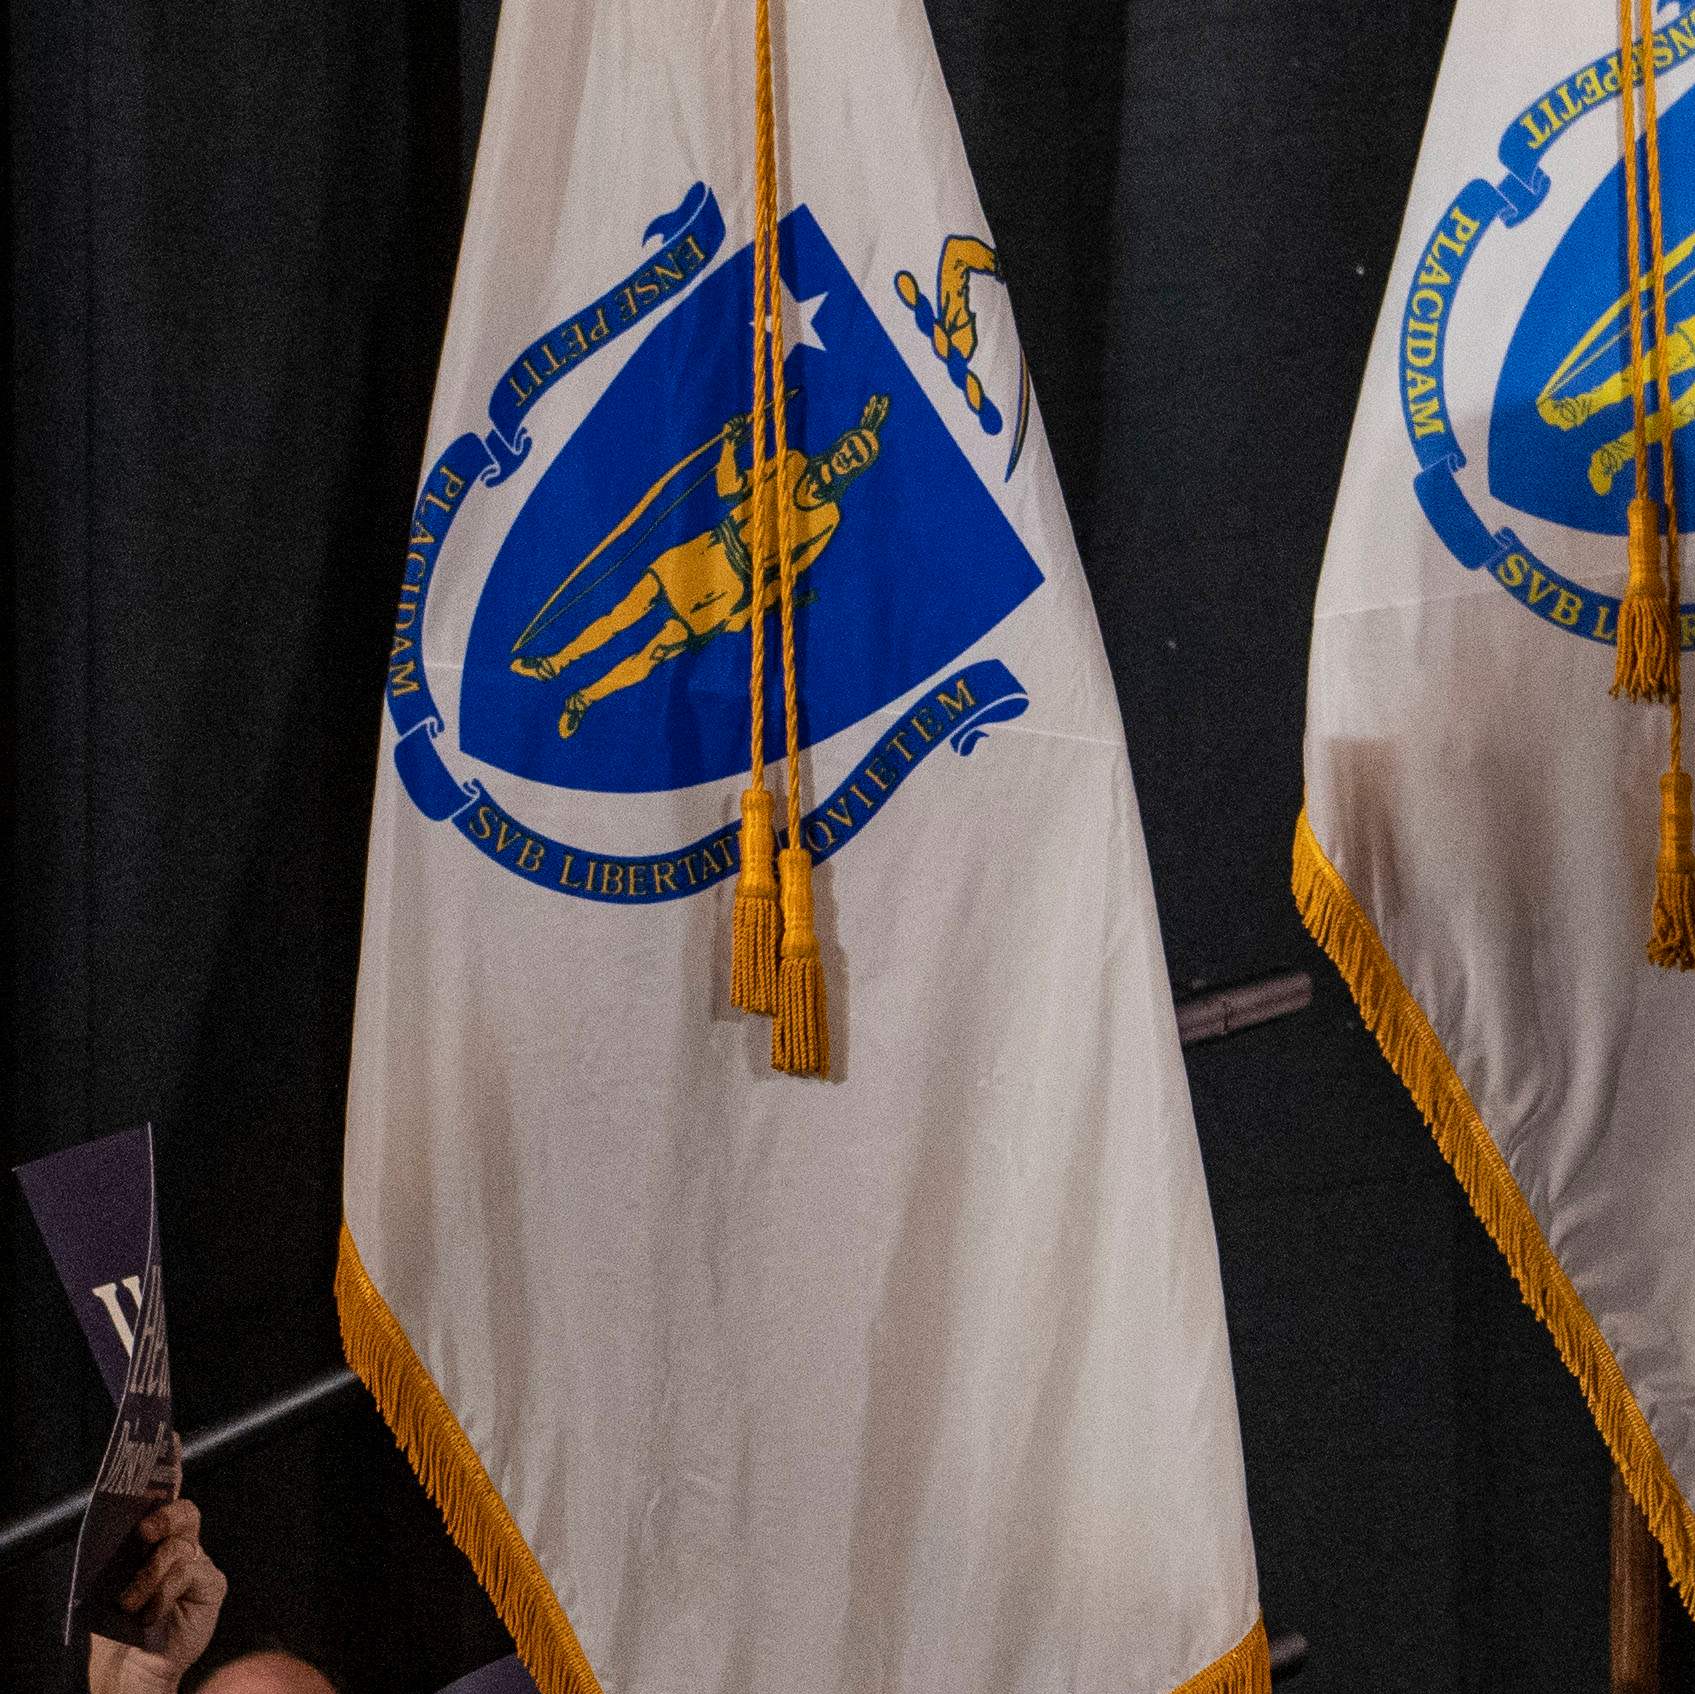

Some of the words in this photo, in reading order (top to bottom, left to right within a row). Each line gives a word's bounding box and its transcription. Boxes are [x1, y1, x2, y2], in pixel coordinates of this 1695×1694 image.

[1520, 55, 1624, 149] PETIT
[614, 234, 706, 323] ENSE
[1405, 206, 1480, 440] PLACIDAM
[508, 307, 611, 408] PETIT
[389, 464, 465, 698] PLACIDAM
[1499, 553, 1583, 626] SVB
[469, 805, 547, 873] SVB
[558, 834, 742, 896] LIBERTAT
